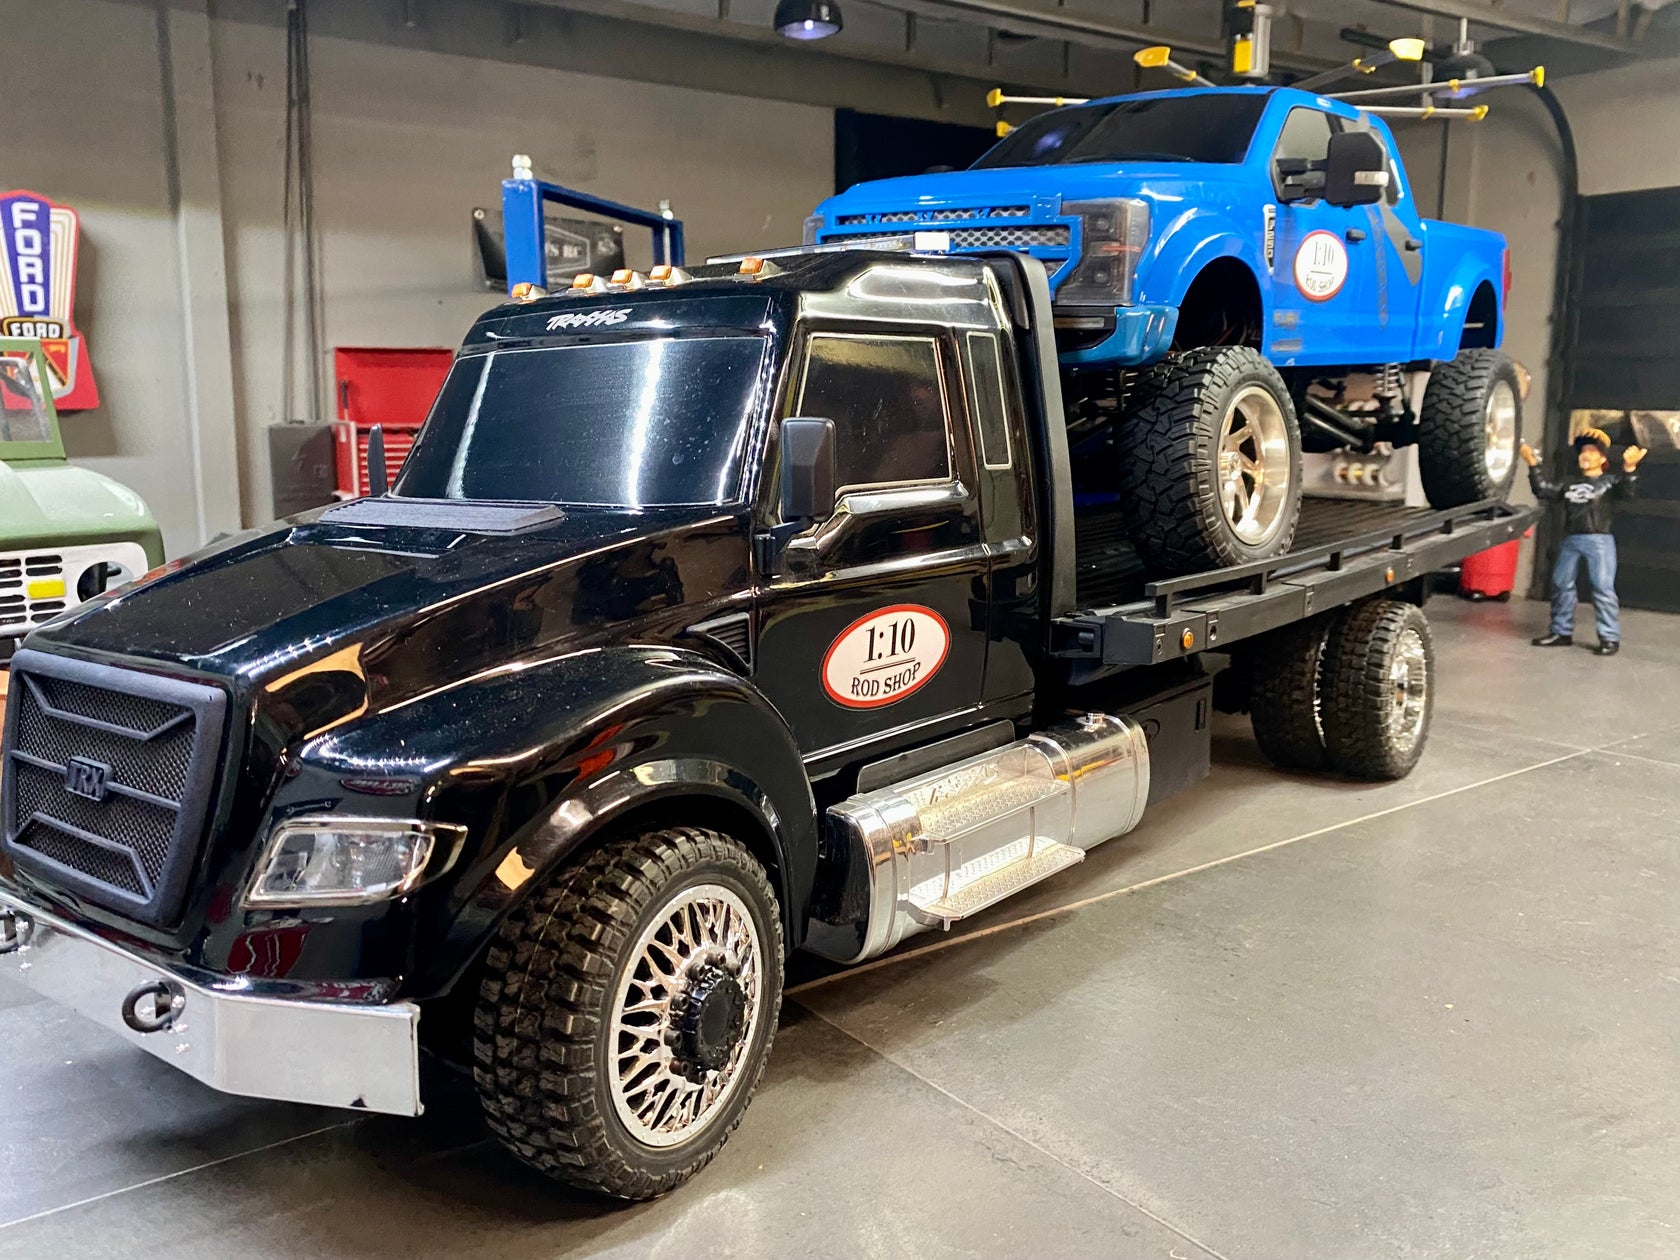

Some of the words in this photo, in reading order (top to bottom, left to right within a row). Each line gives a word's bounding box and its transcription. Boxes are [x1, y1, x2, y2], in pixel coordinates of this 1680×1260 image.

[11, 202, 46, 312] FORD
[10, 322, 60, 338] FORD
[545, 308, 633, 331] TRAXXAS
[863, 618, 916, 664] 1:10
[851, 676, 880, 697] ROD
[882, 661, 921, 695] SHOP
[66, 760, 104, 801] TRX
